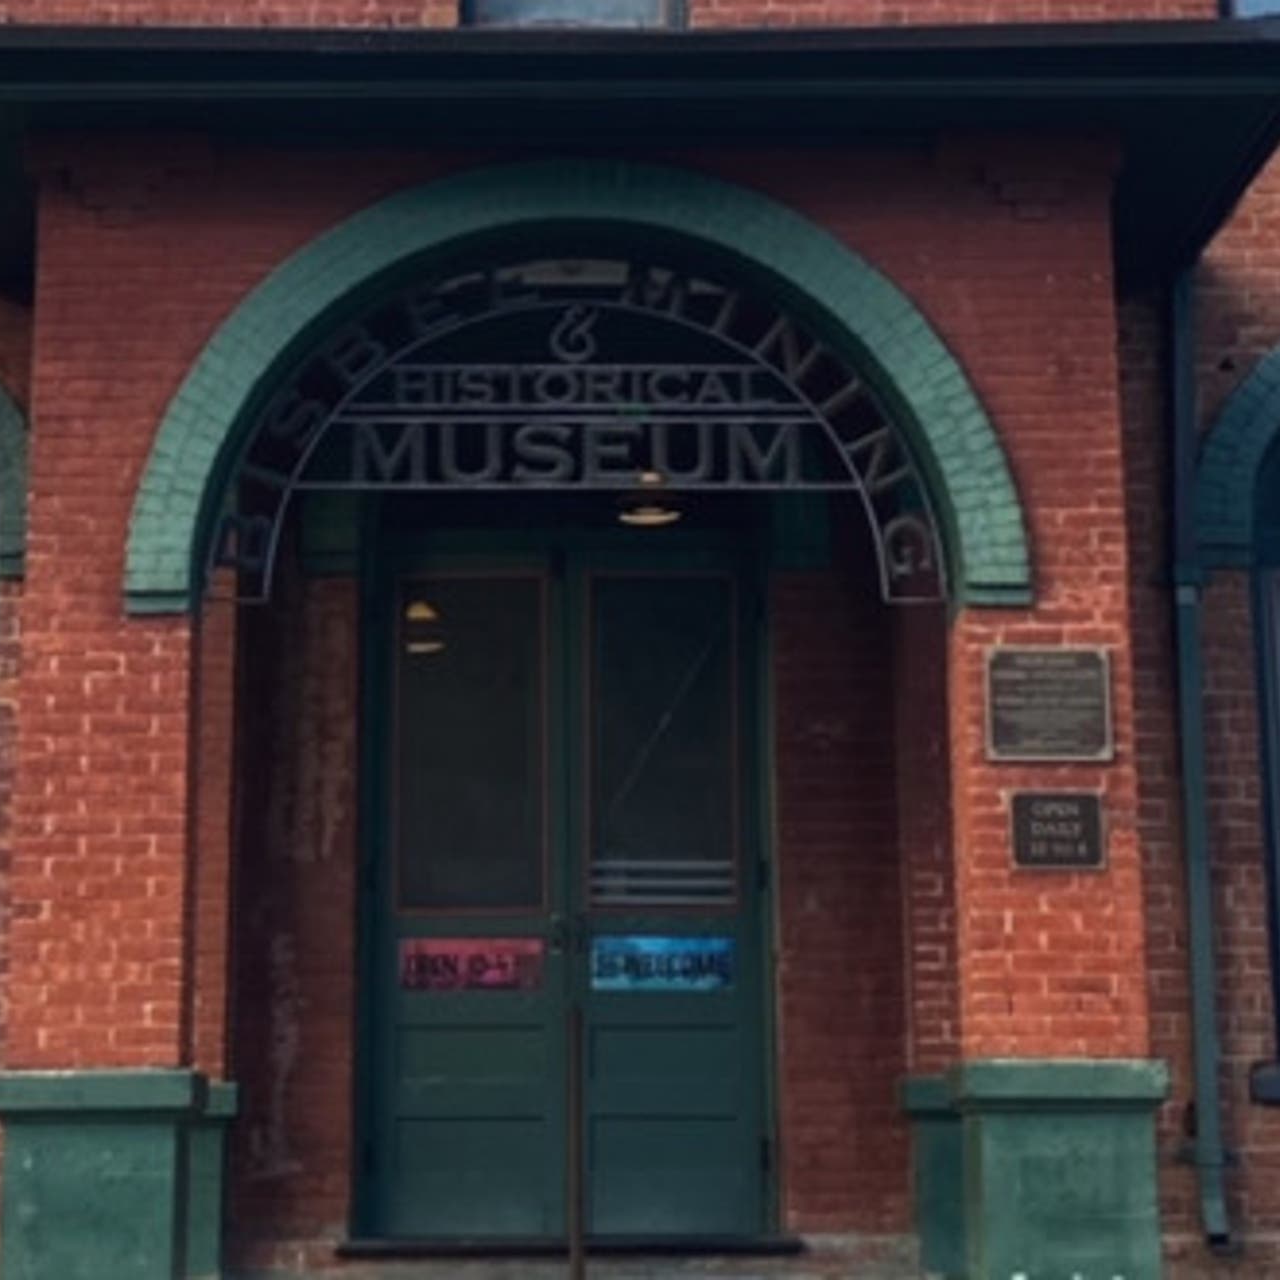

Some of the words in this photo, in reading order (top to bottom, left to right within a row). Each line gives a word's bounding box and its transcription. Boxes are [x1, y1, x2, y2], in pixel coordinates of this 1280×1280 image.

[548, 304, 596, 365] &
[395, 370, 780, 406] HISTORICAL
[352, 422, 805, 484] MUSEUM
